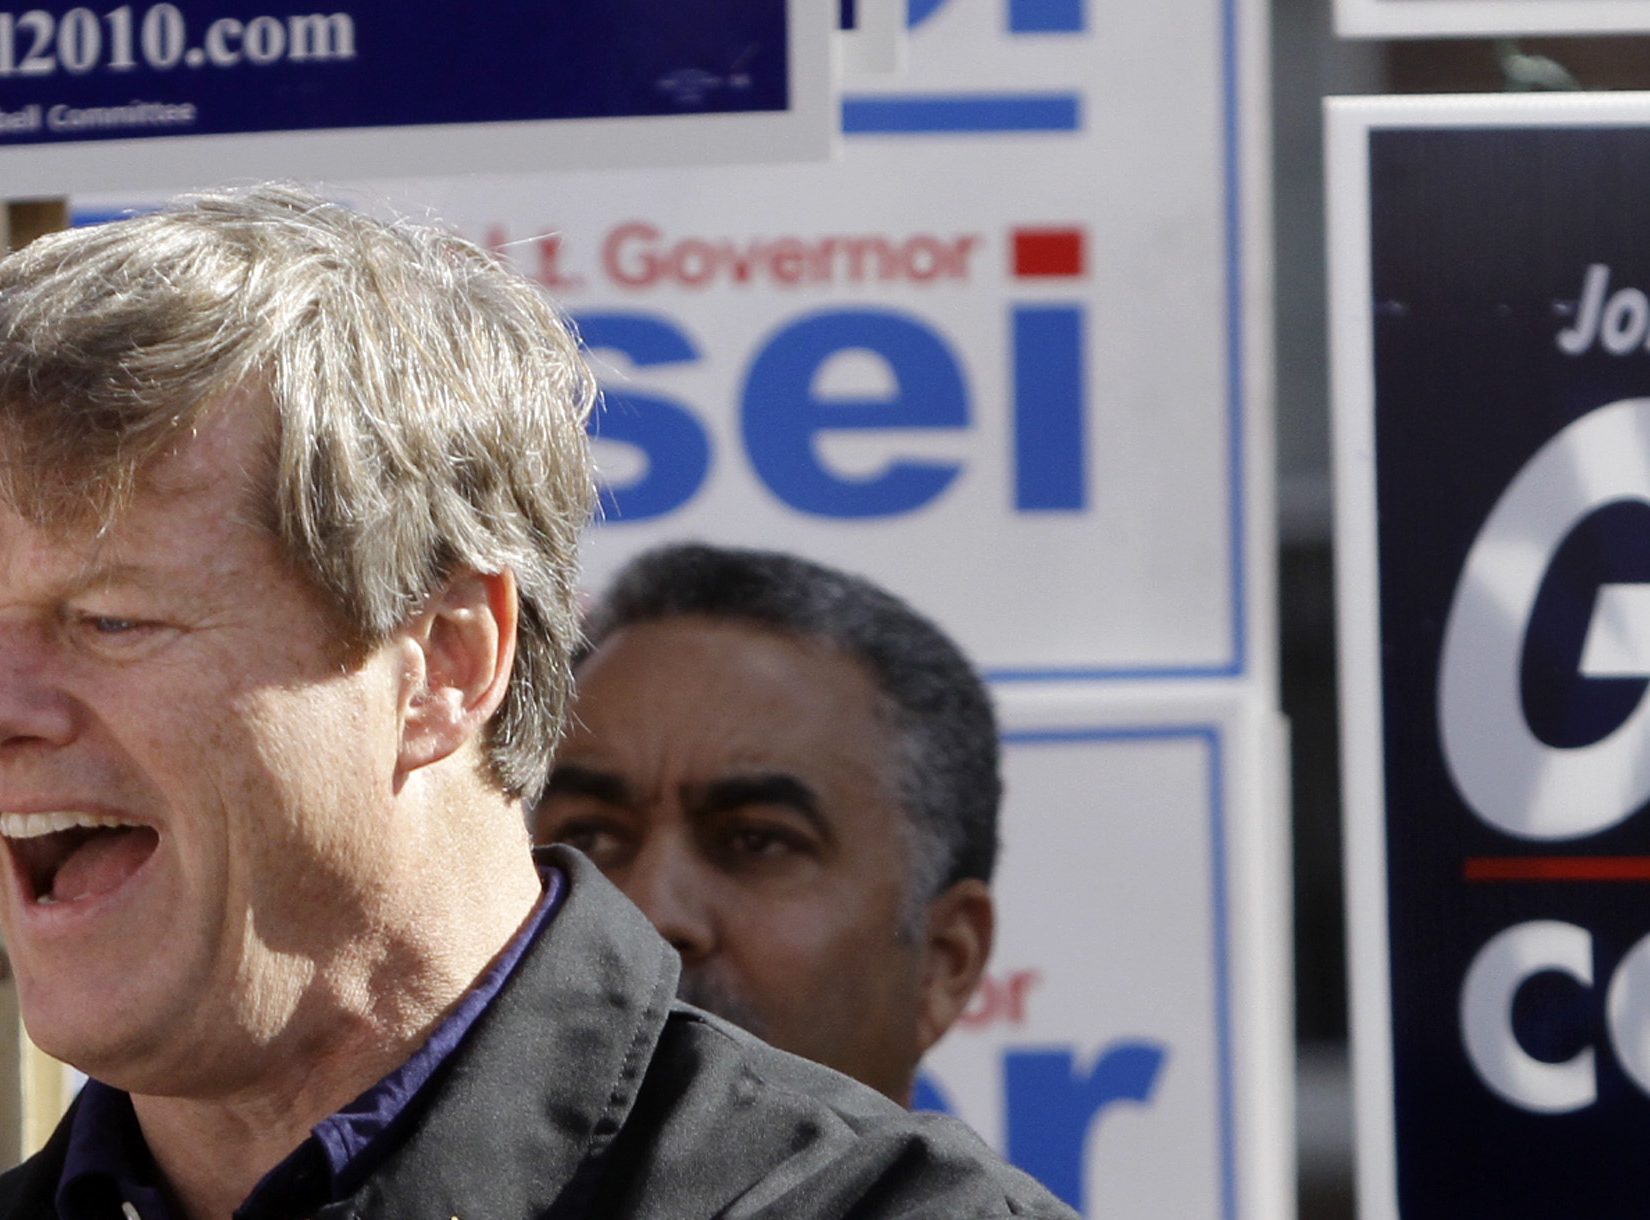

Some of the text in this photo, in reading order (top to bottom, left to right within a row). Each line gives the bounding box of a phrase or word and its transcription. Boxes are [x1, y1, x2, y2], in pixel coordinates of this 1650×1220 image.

[47, 101, 197, 131] Committee
[601, 221, 977, 289] Governor
[1556, 263, 1650, 355] Jo
